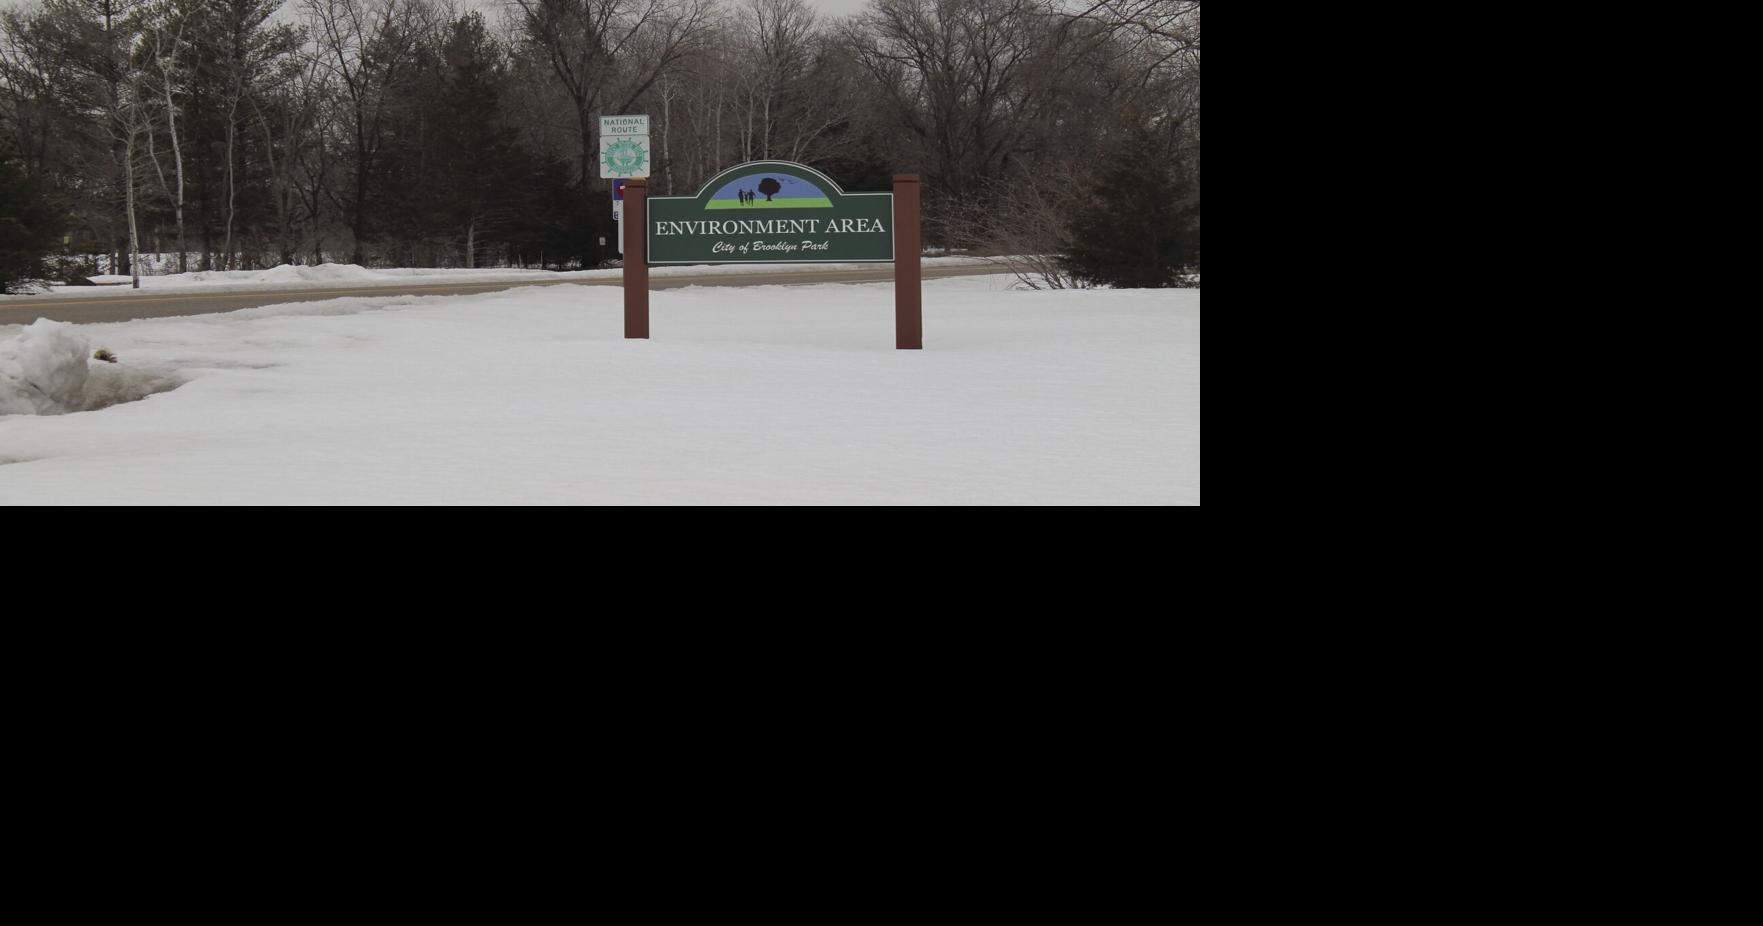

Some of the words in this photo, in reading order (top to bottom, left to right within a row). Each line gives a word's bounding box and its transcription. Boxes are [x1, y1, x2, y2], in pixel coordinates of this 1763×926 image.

[603, 118, 644, 126] NATIONAL
[655, 219, 820, 235] ENVIRONMENT
[824, 218, 886, 233] AREA
[712, 241, 735, 253] City
[738, 242, 750, 254] of
[752, 240, 798, 253] Brooklyn
[801, 240, 829, 251] Park
